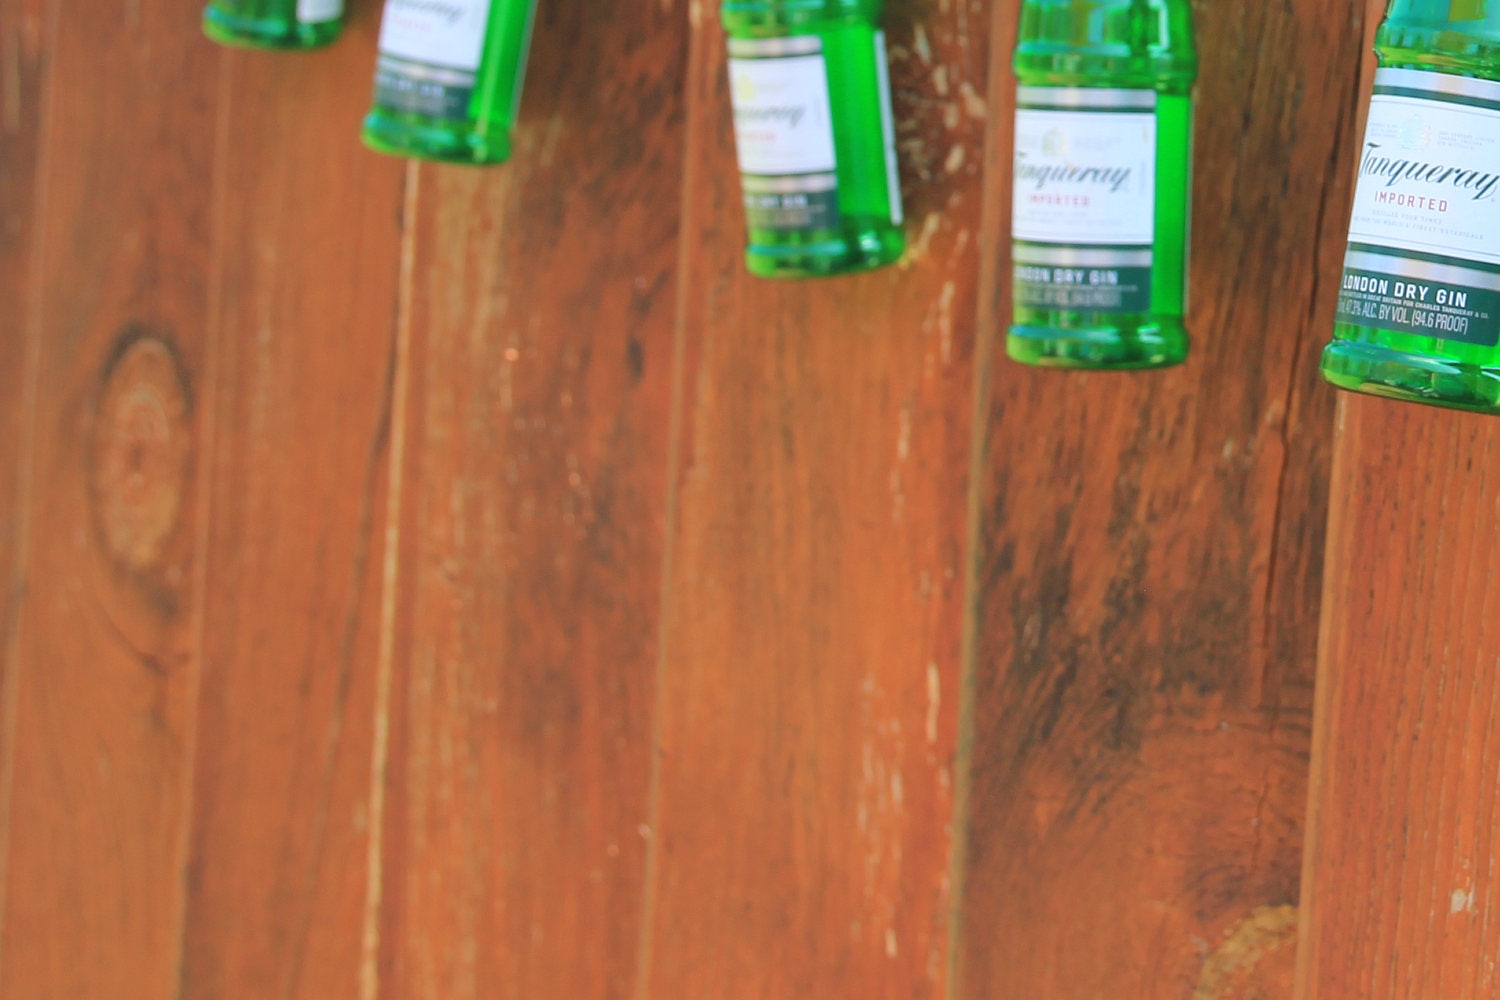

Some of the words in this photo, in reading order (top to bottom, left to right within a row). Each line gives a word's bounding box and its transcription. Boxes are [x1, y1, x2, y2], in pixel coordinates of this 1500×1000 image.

[1359, 142, 1500, 201] Tanqueray
[1374, 191, 1448, 212] IMPORTED
[1343, 274, 1388, 295] LONDON
[1394, 282, 1429, 301] DRY
[1436, 289, 1467, 308] GIN
[1379, 304, 1392, 320] BY
[1391, 306, 1410, 324] VOL.
[1411, 309, 1434, 328] (94.6
[1435, 313, 1469, 335] PROOF)
